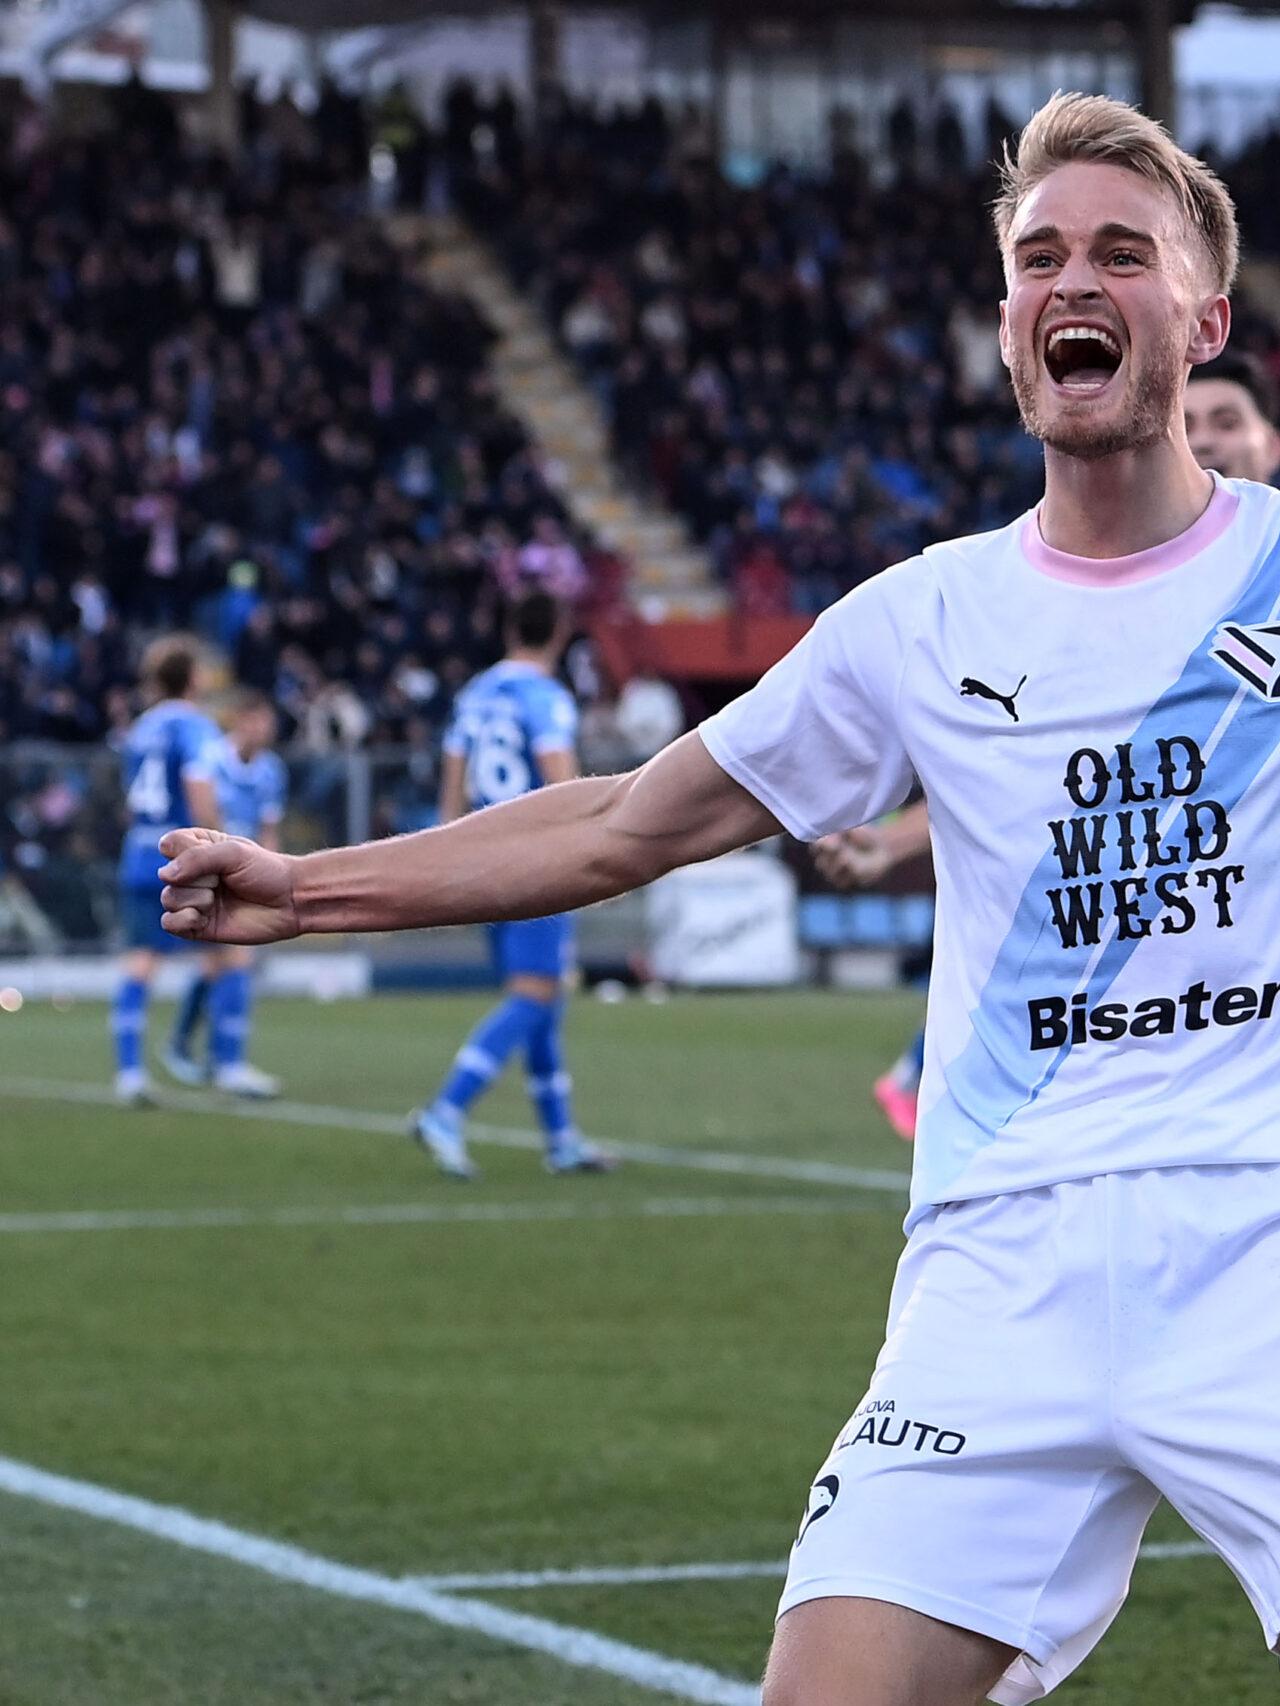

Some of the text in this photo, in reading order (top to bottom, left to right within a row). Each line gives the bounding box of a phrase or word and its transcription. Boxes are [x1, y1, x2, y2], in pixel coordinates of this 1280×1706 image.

[1063, 736, 1206, 809] OLD
[1047, 800, 1232, 879] WILD
[1045, 865, 1245, 949] WEST
